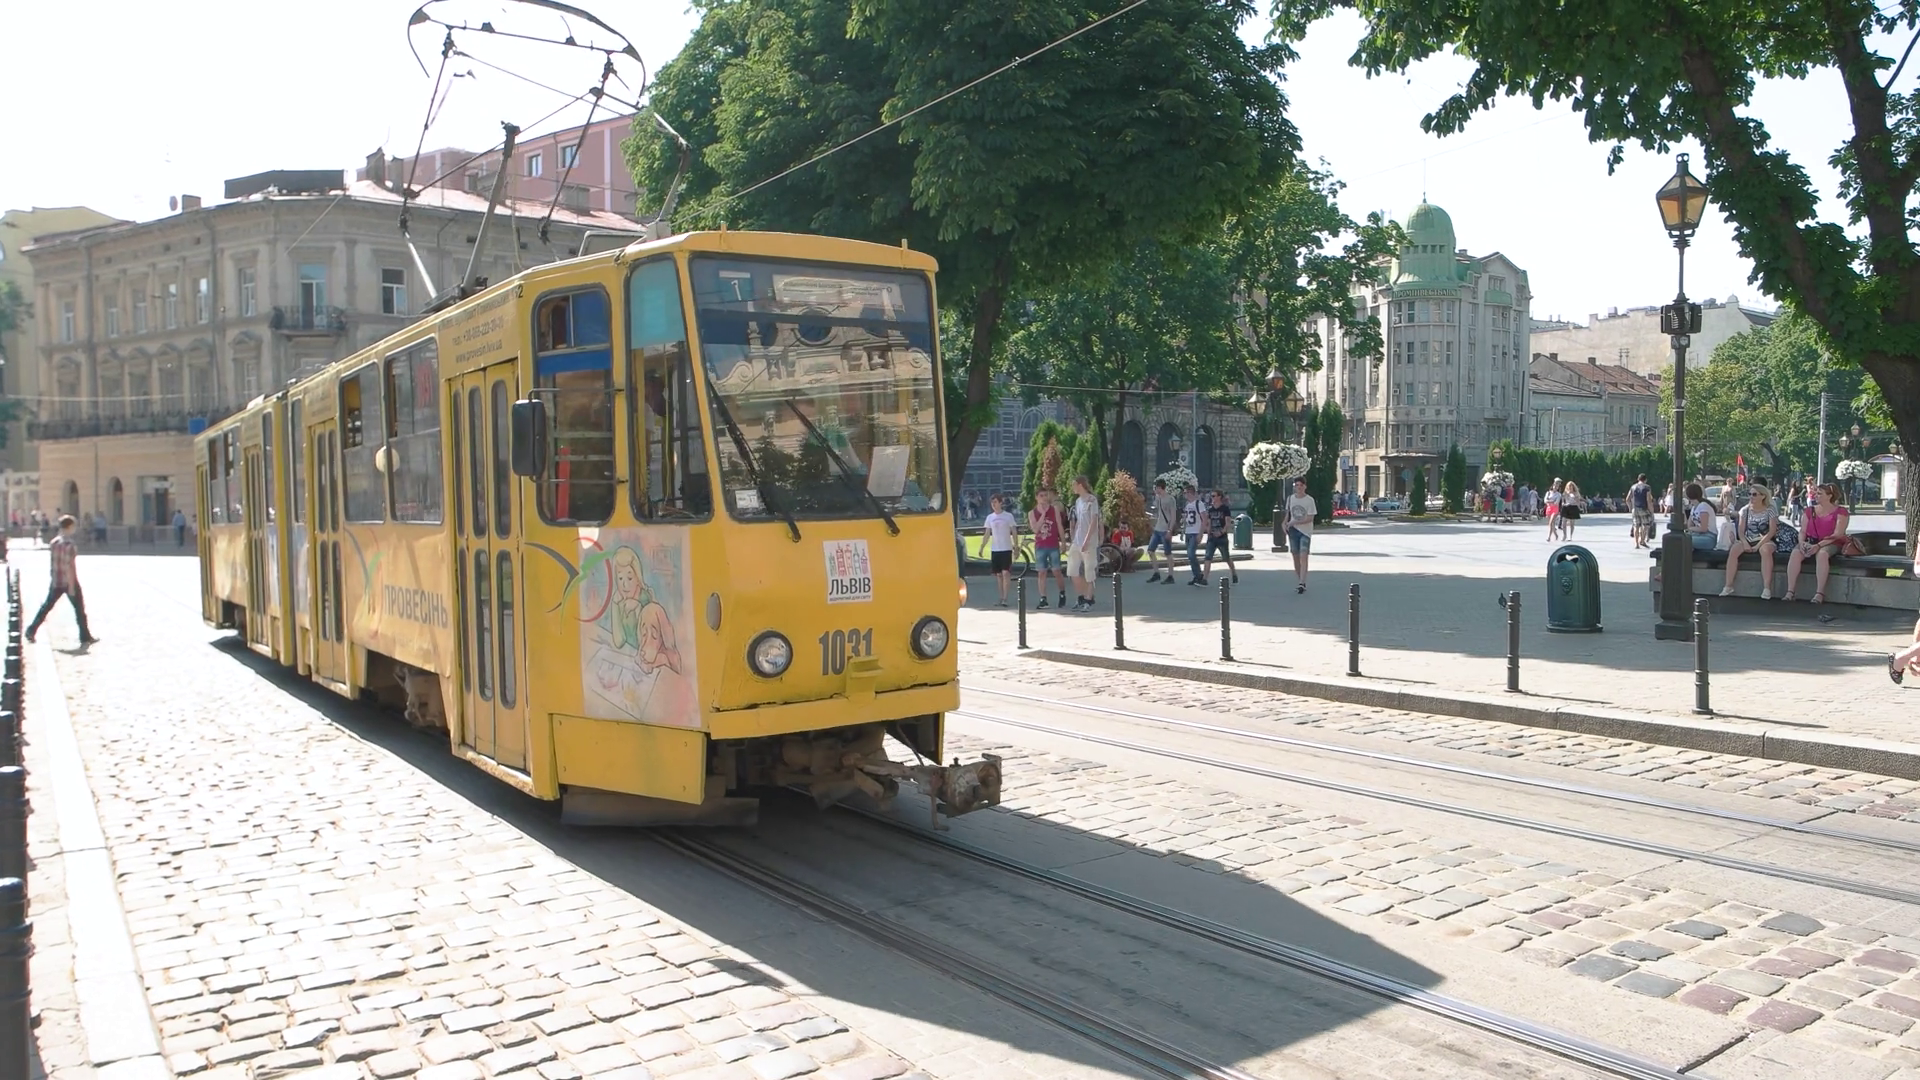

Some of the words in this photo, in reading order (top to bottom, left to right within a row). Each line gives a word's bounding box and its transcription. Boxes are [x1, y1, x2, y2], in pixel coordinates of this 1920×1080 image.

[384, 585, 448, 629] ПРОВЕСІНЬ
[829, 577, 872, 596] ЛЬВІВ
[819, 627, 873, 676] 1031
